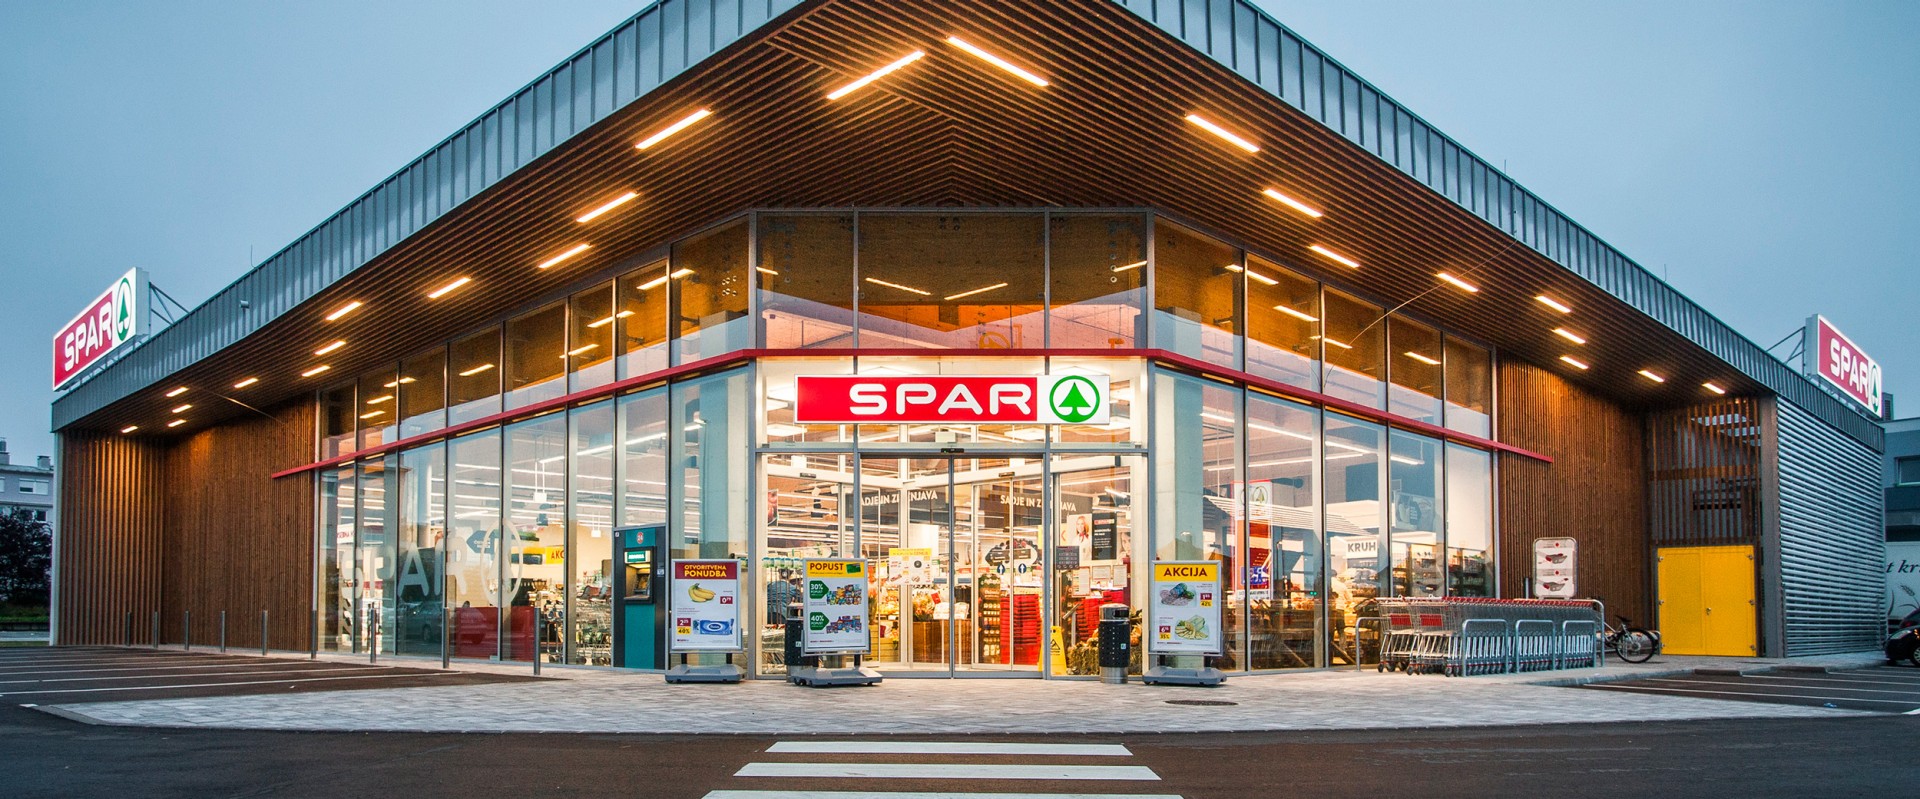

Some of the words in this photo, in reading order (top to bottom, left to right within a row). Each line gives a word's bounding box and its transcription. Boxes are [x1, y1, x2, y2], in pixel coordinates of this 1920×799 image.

[64, 301, 112, 372] SPAR
[1830, 337, 1868, 399] SPAR
[849, 383, 1032, 415] SPAR
[1347, 542, 1376, 552] KRUH
[1163, 567, 1208, 577] AKCIJA
